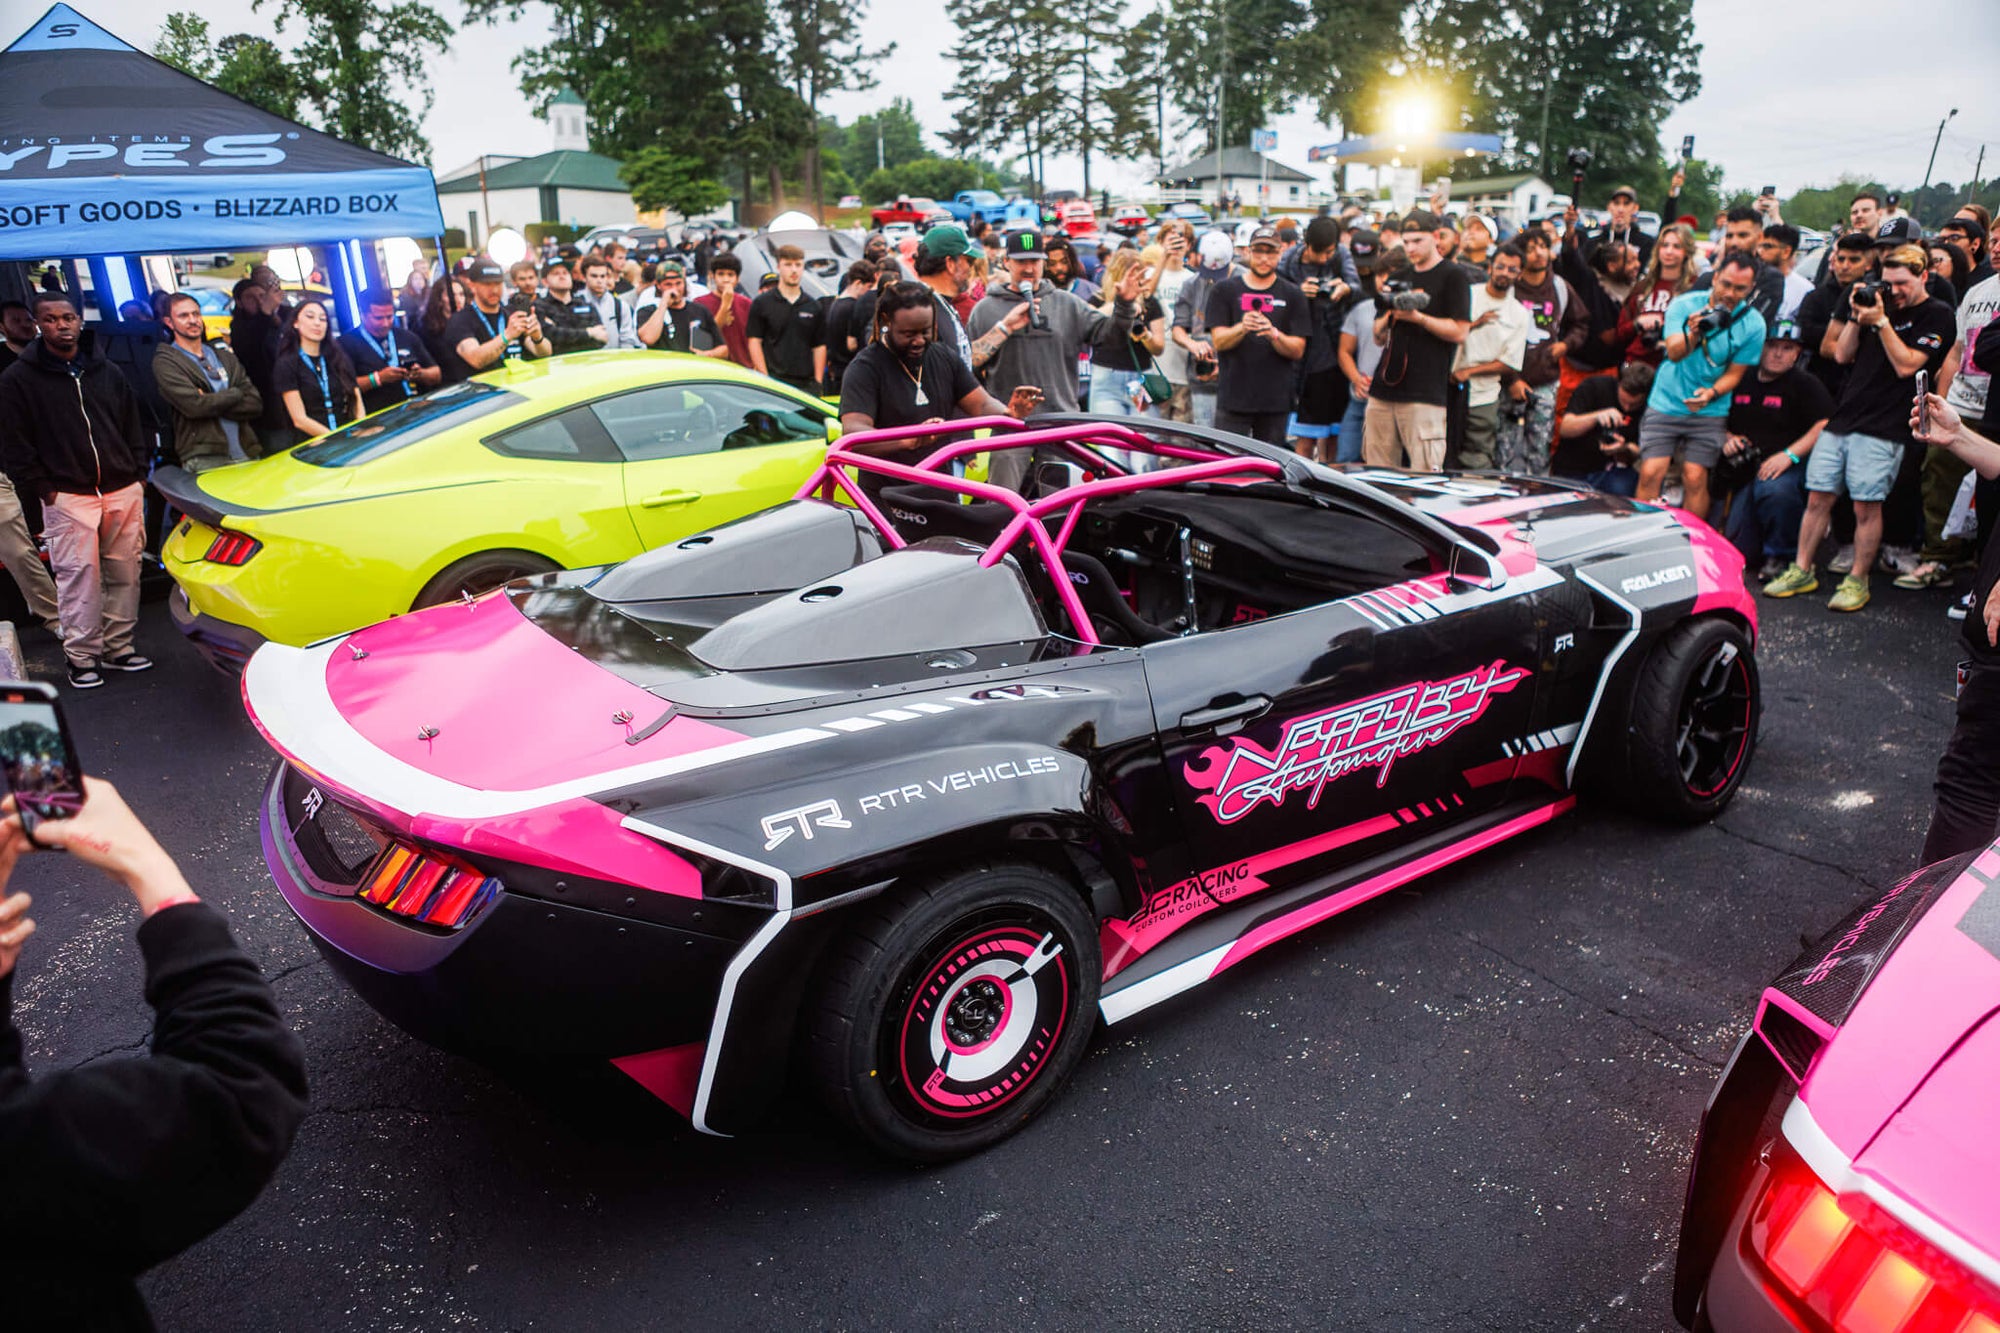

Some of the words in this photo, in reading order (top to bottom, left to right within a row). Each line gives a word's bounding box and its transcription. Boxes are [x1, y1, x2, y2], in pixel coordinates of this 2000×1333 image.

[92, 135, 191, 143] ITEMS
[79, 200, 182, 222] GOODS
[215, 197, 340, 217] BLIZZARD
[349, 194, 399, 213] BOX
[1621, 564, 1692, 594] FALKEN
[859, 783, 927, 815] RTR
[927, 756, 1060, 793] VEHICLES
[1135, 908, 1175, 933] CUSTOM
[1802, 895, 1897, 986] VEHICLES
